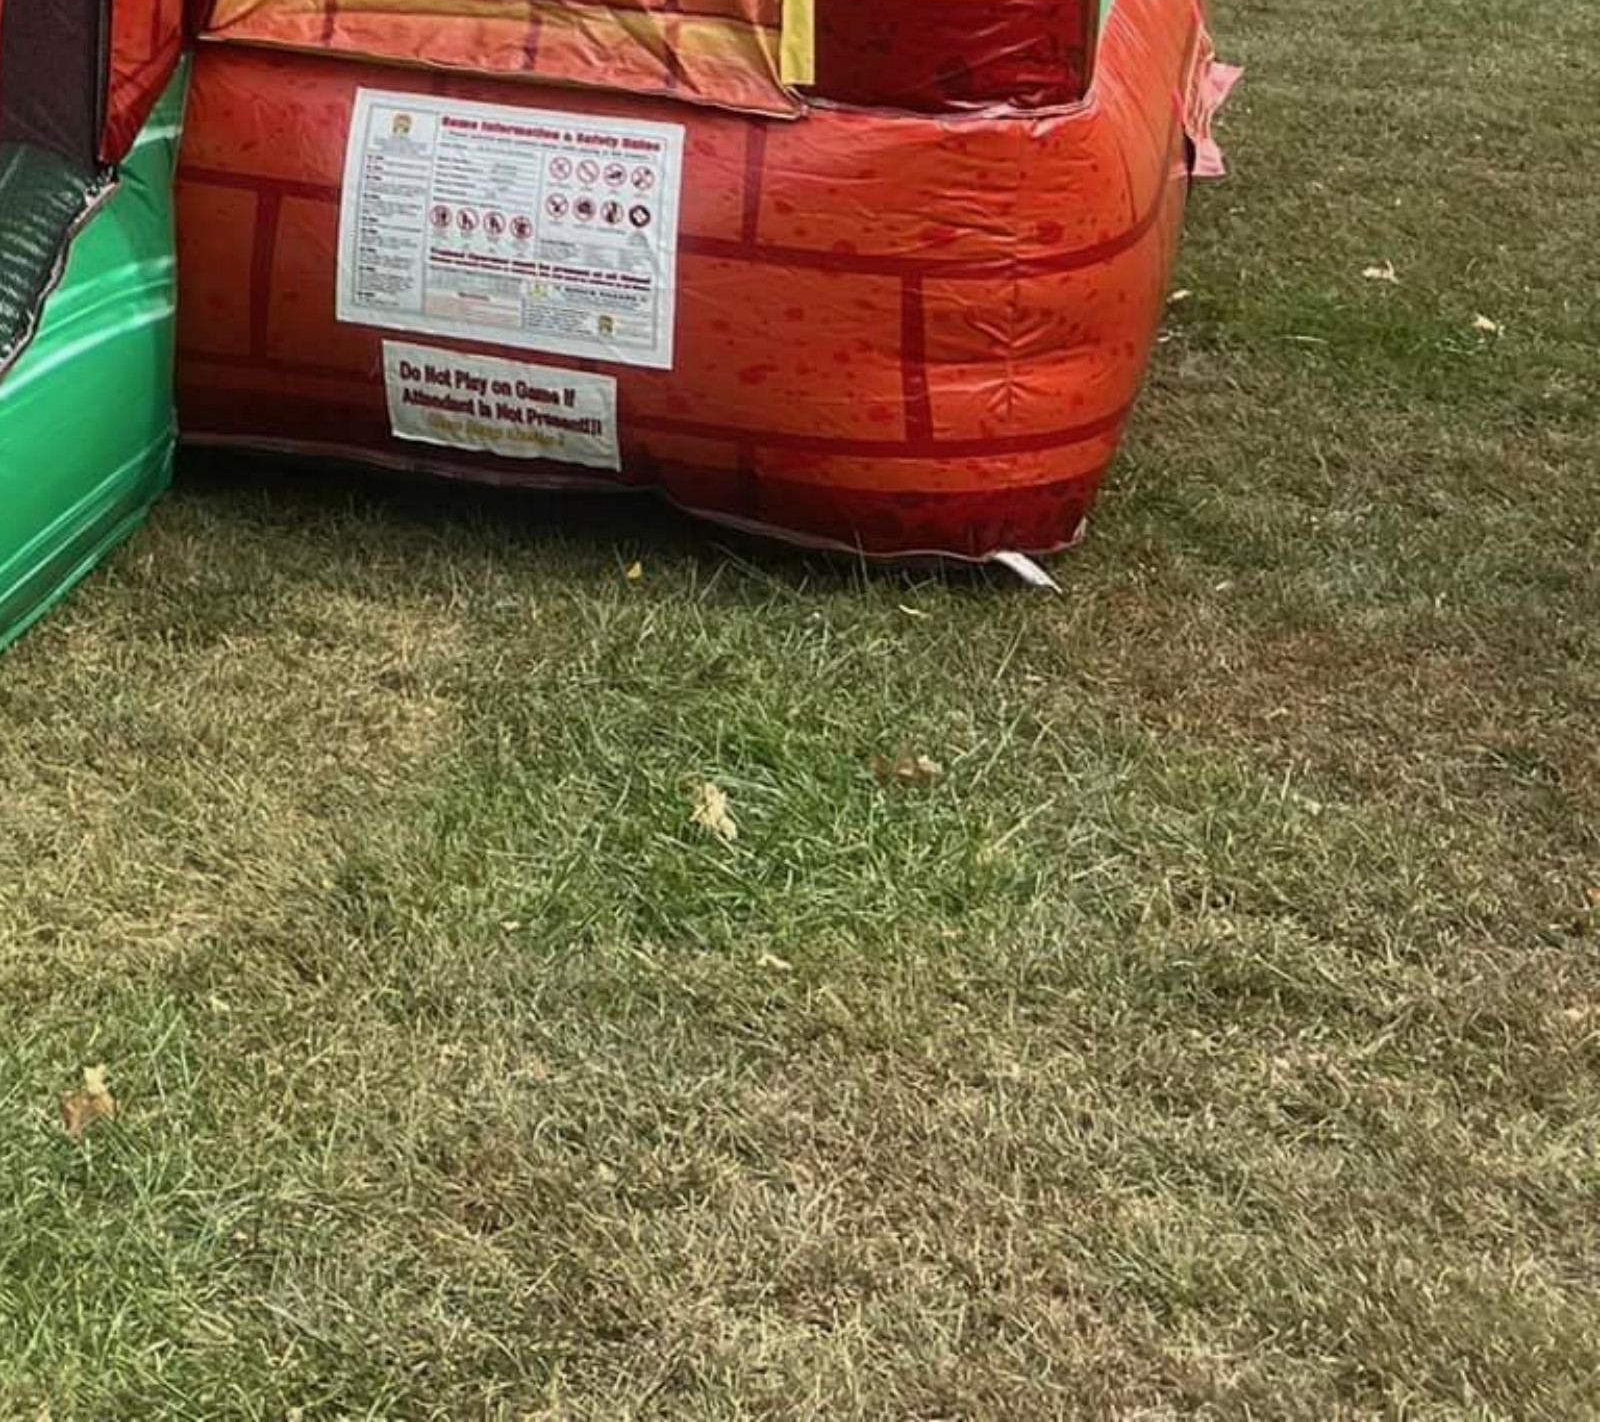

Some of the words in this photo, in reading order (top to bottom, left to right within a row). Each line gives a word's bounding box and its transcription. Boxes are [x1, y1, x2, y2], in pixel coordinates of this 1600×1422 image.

[576, 132, 619, 148] Safety
[400, 361, 421, 381] Do
[425, 364, 451, 388] Not
[455, 369, 488, 396] Play
[491, 381, 511, 397] on
[516, 380, 560, 406] Game
[402, 388, 475, 416] Attendant
[496, 402, 522, 424] Not
